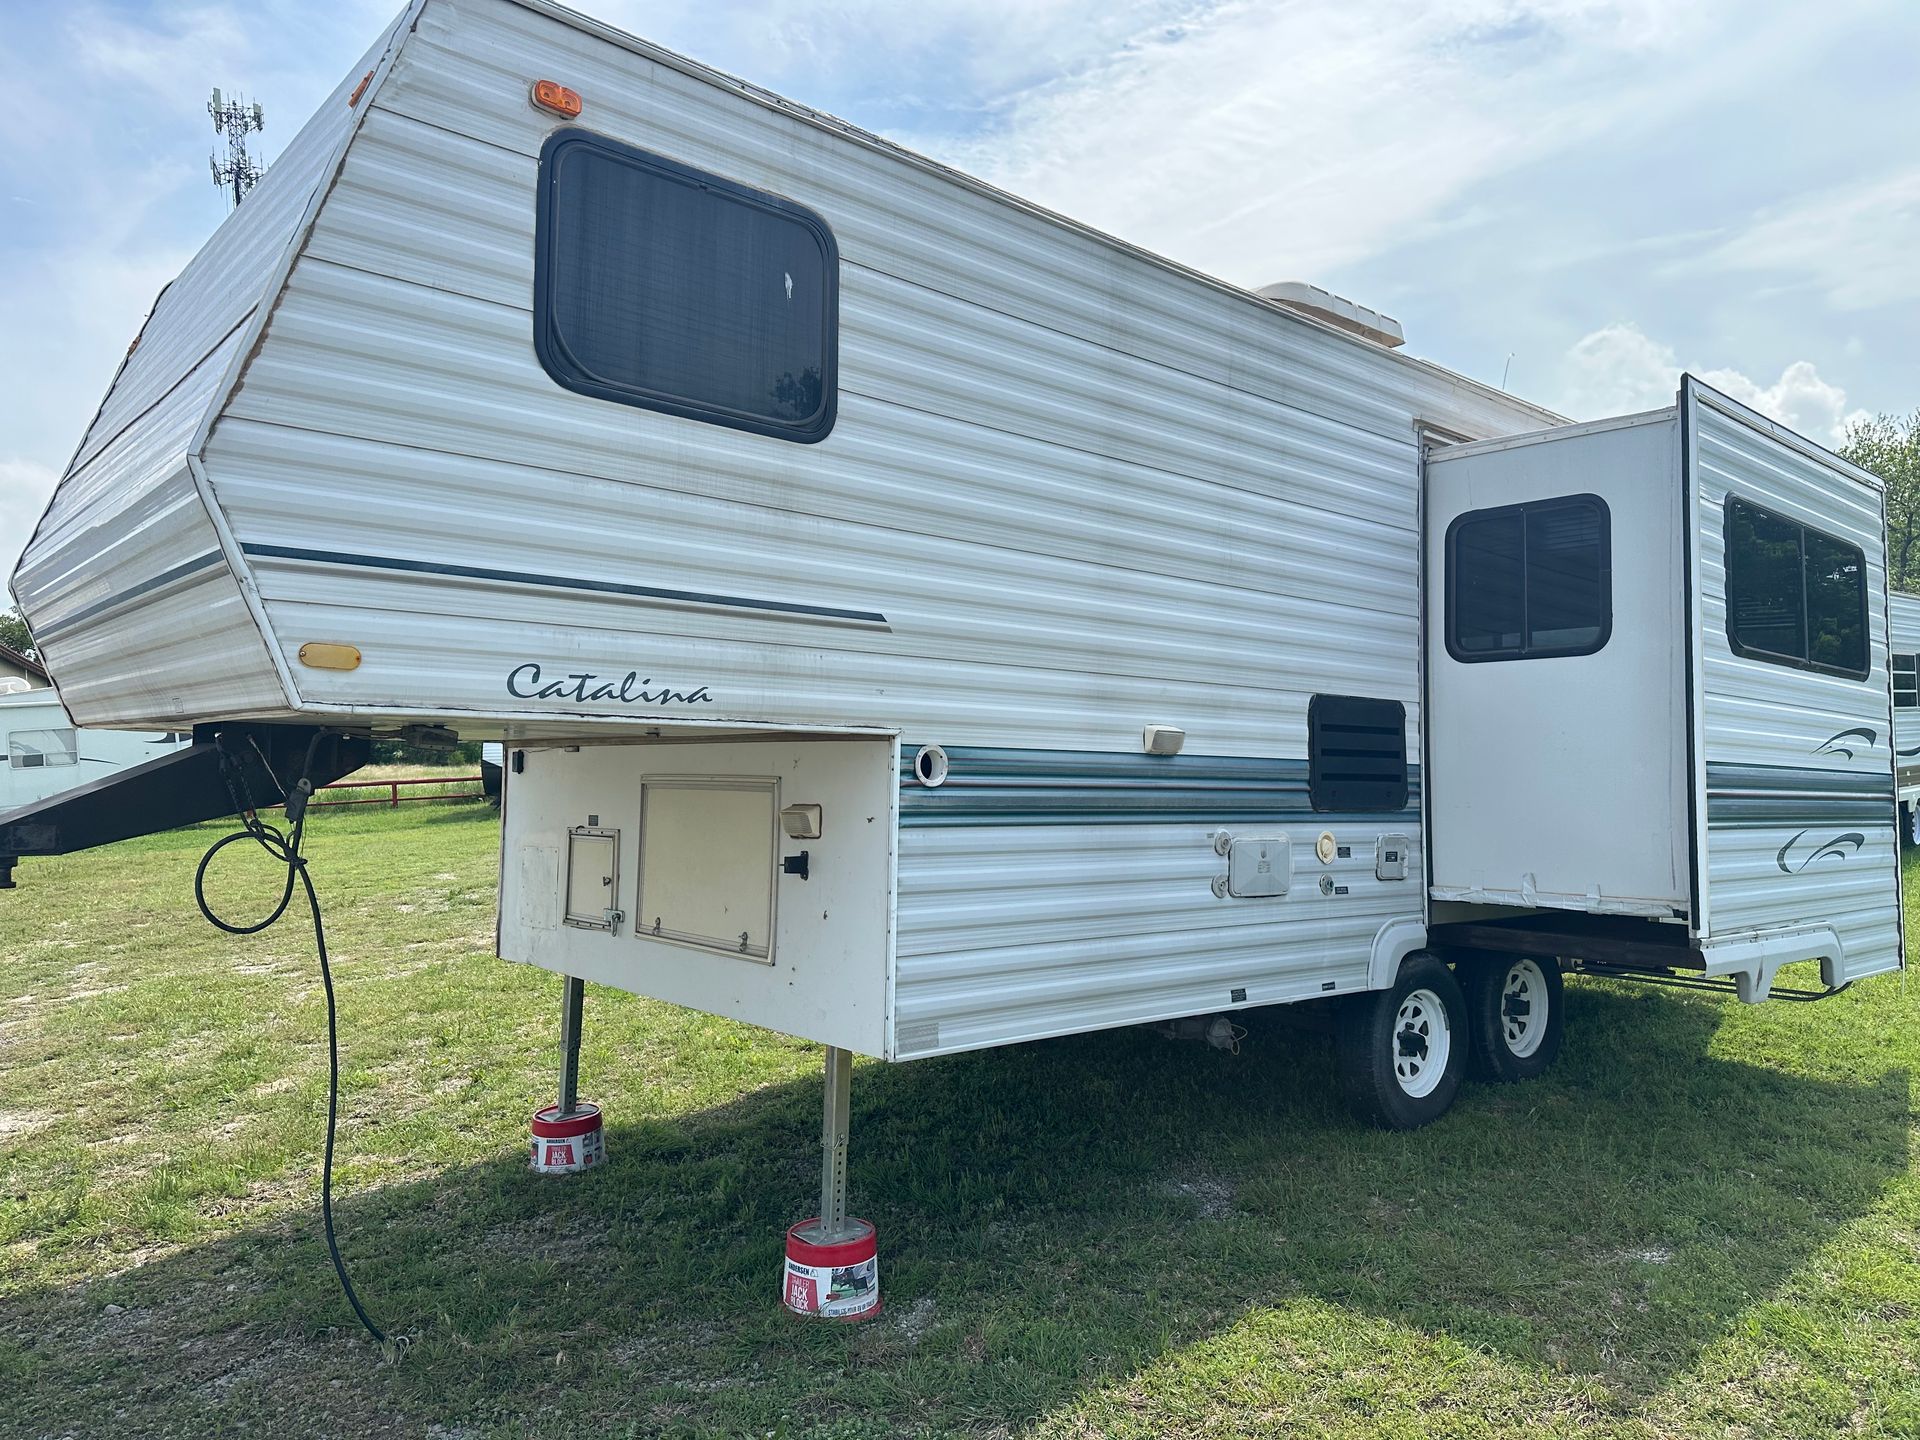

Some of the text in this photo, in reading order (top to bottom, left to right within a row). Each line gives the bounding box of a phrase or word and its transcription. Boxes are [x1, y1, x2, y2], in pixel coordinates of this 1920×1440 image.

[507, 663, 713, 705] Catalina
[552, 1151, 566, 1159] JACK
[791, 1284, 808, 1300] JACK
[790, 1296, 809, 1311] BLOCK
